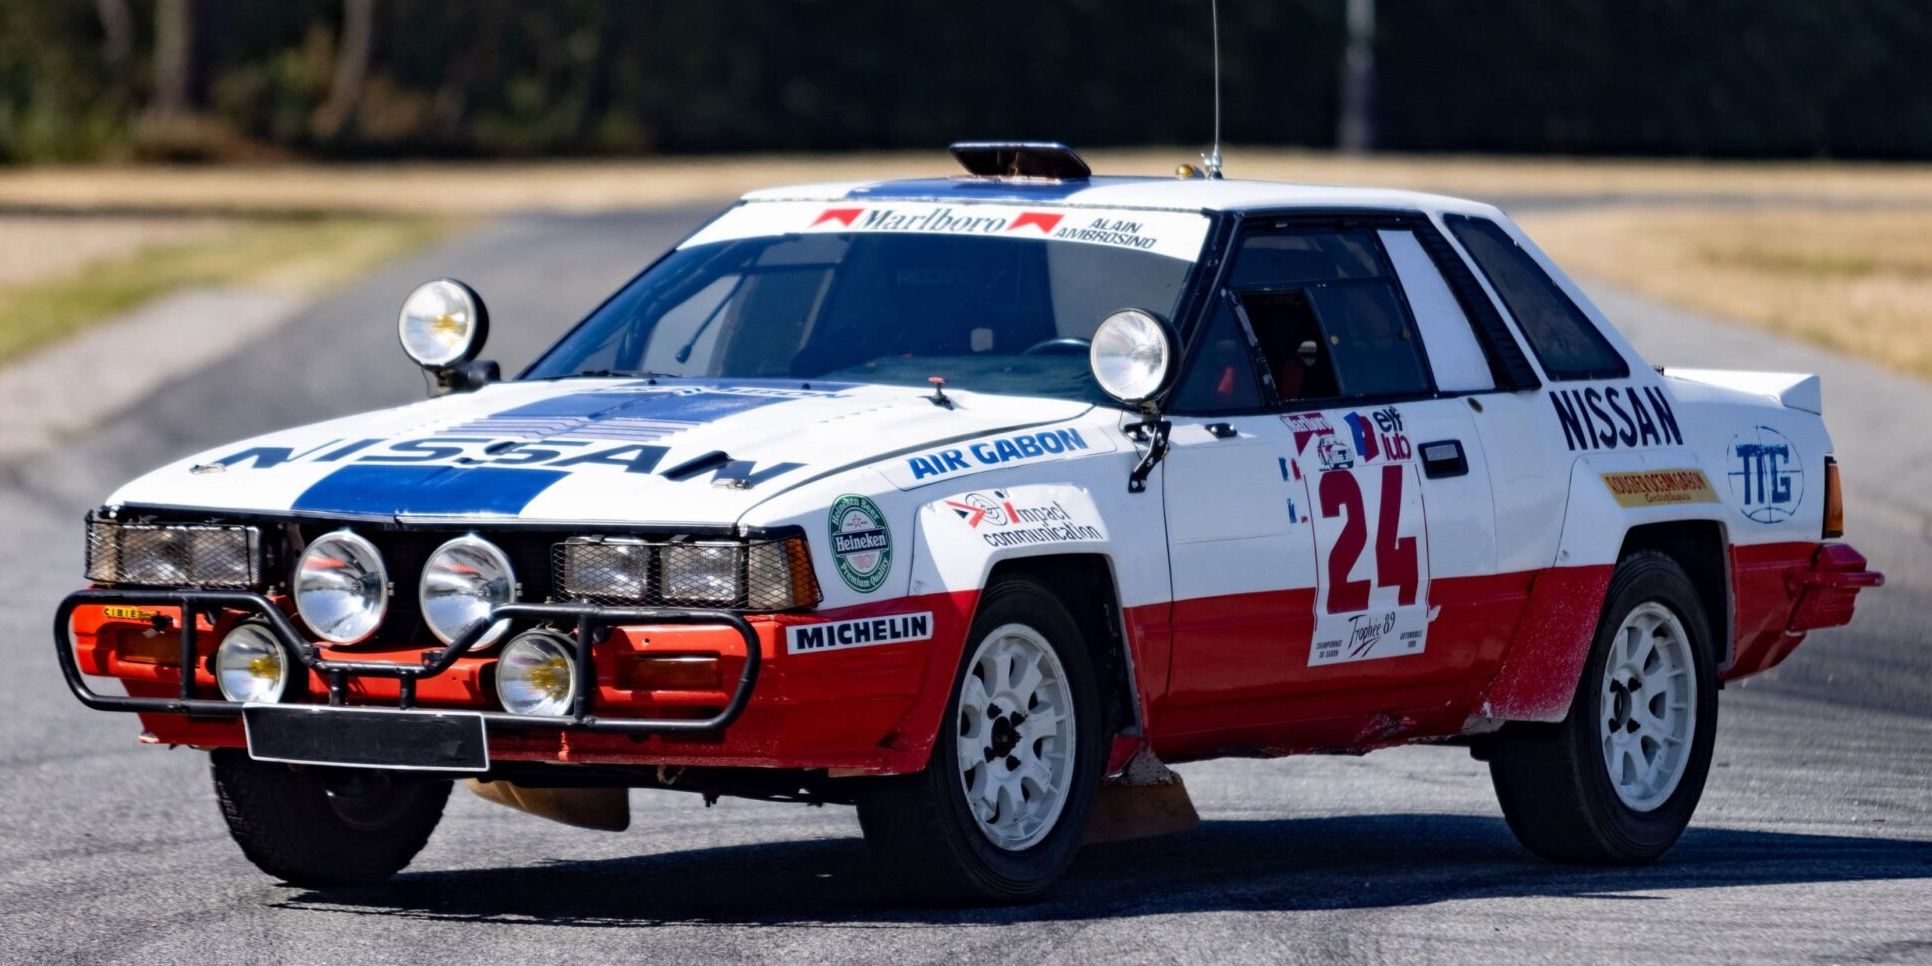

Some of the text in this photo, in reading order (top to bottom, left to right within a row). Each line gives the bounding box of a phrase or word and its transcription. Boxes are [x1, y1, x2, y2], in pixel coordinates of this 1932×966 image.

[862, 208, 1007, 232] Marlboro
[1089, 218, 1143, 233] ALAIN
[1055, 228, 1157, 249] AMBROSINO
[1373, 405, 1404, 432] elf
[1549, 386, 1683, 451] NISSAN
[213, 437, 806, 488] NISSAN
[907, 428, 1089, 480] AIR GABON
[835, 533, 887, 552] Heineken
[983, 521, 1103, 547] communication
[1319, 464, 1419, 615] 24
[841, 556, 889, 588] Premium Quality
[104, 608, 136, 618] CIBIE
[1383, 611, 1397, 635] 89
[796, 615, 928, 650] MICHELIN
